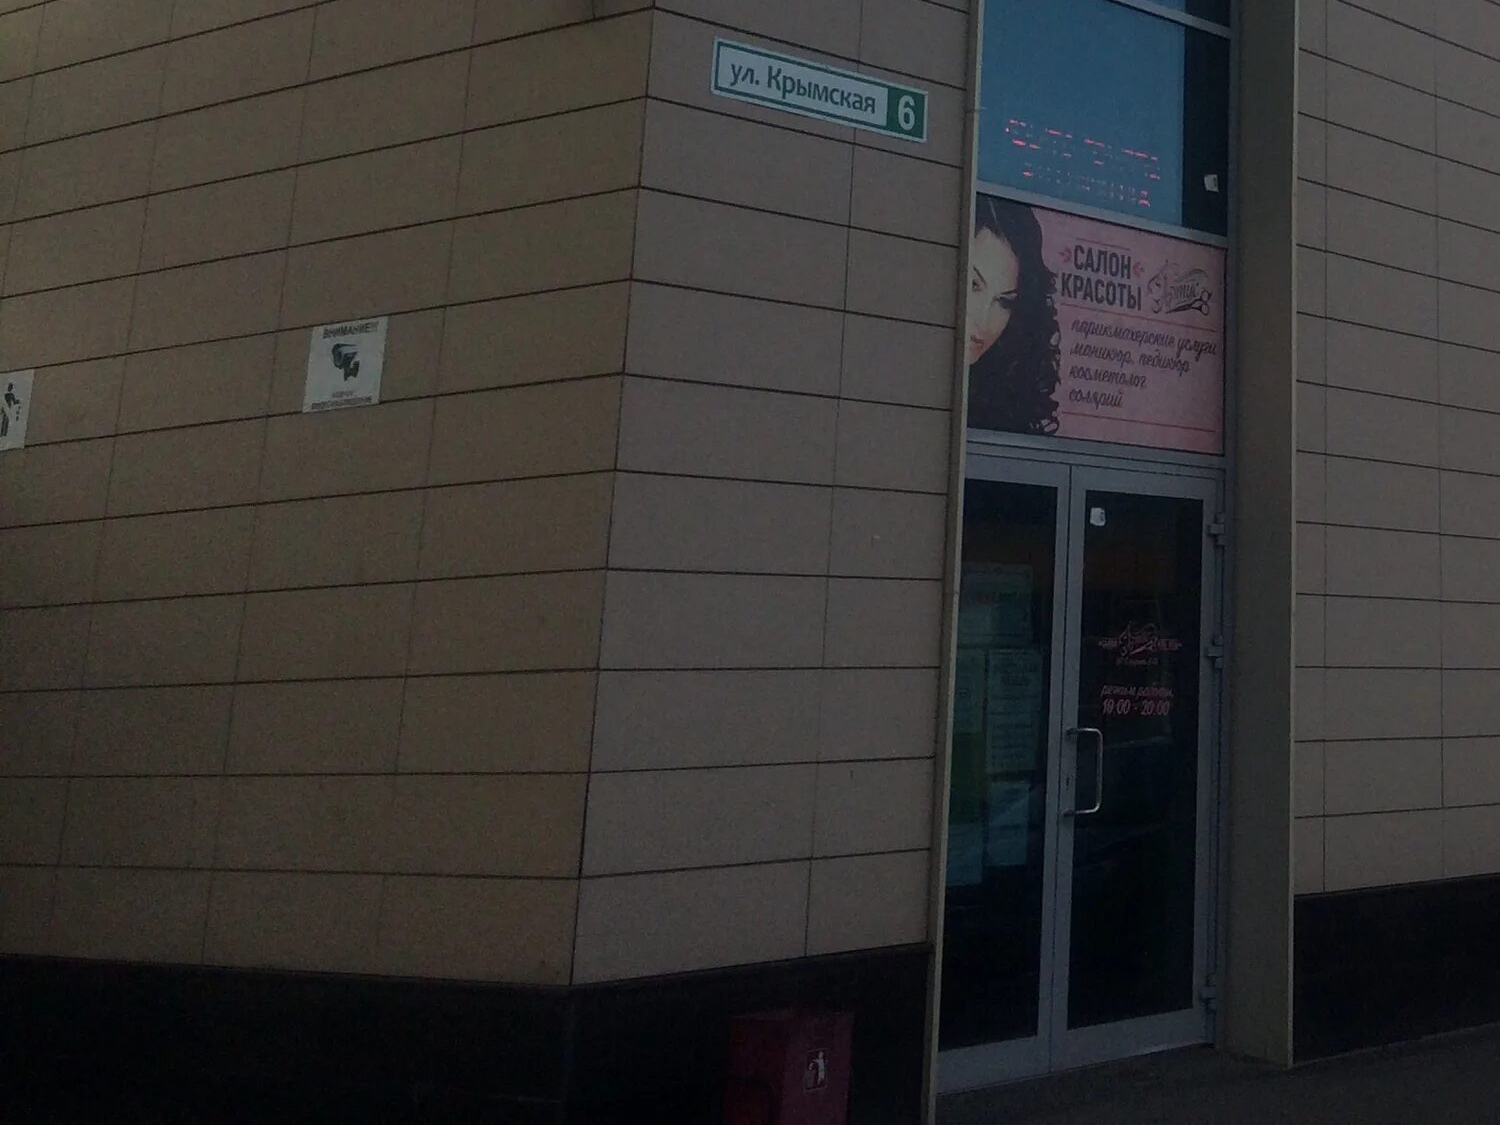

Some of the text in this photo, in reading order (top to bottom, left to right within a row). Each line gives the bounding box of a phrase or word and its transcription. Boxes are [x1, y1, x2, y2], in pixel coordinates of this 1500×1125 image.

[730, 63, 915, 130] ул. Крымская 6
[1073, 245, 1132, 279] САЛОН
[1061, 272, 1142, 311] КРАСОТЫ
